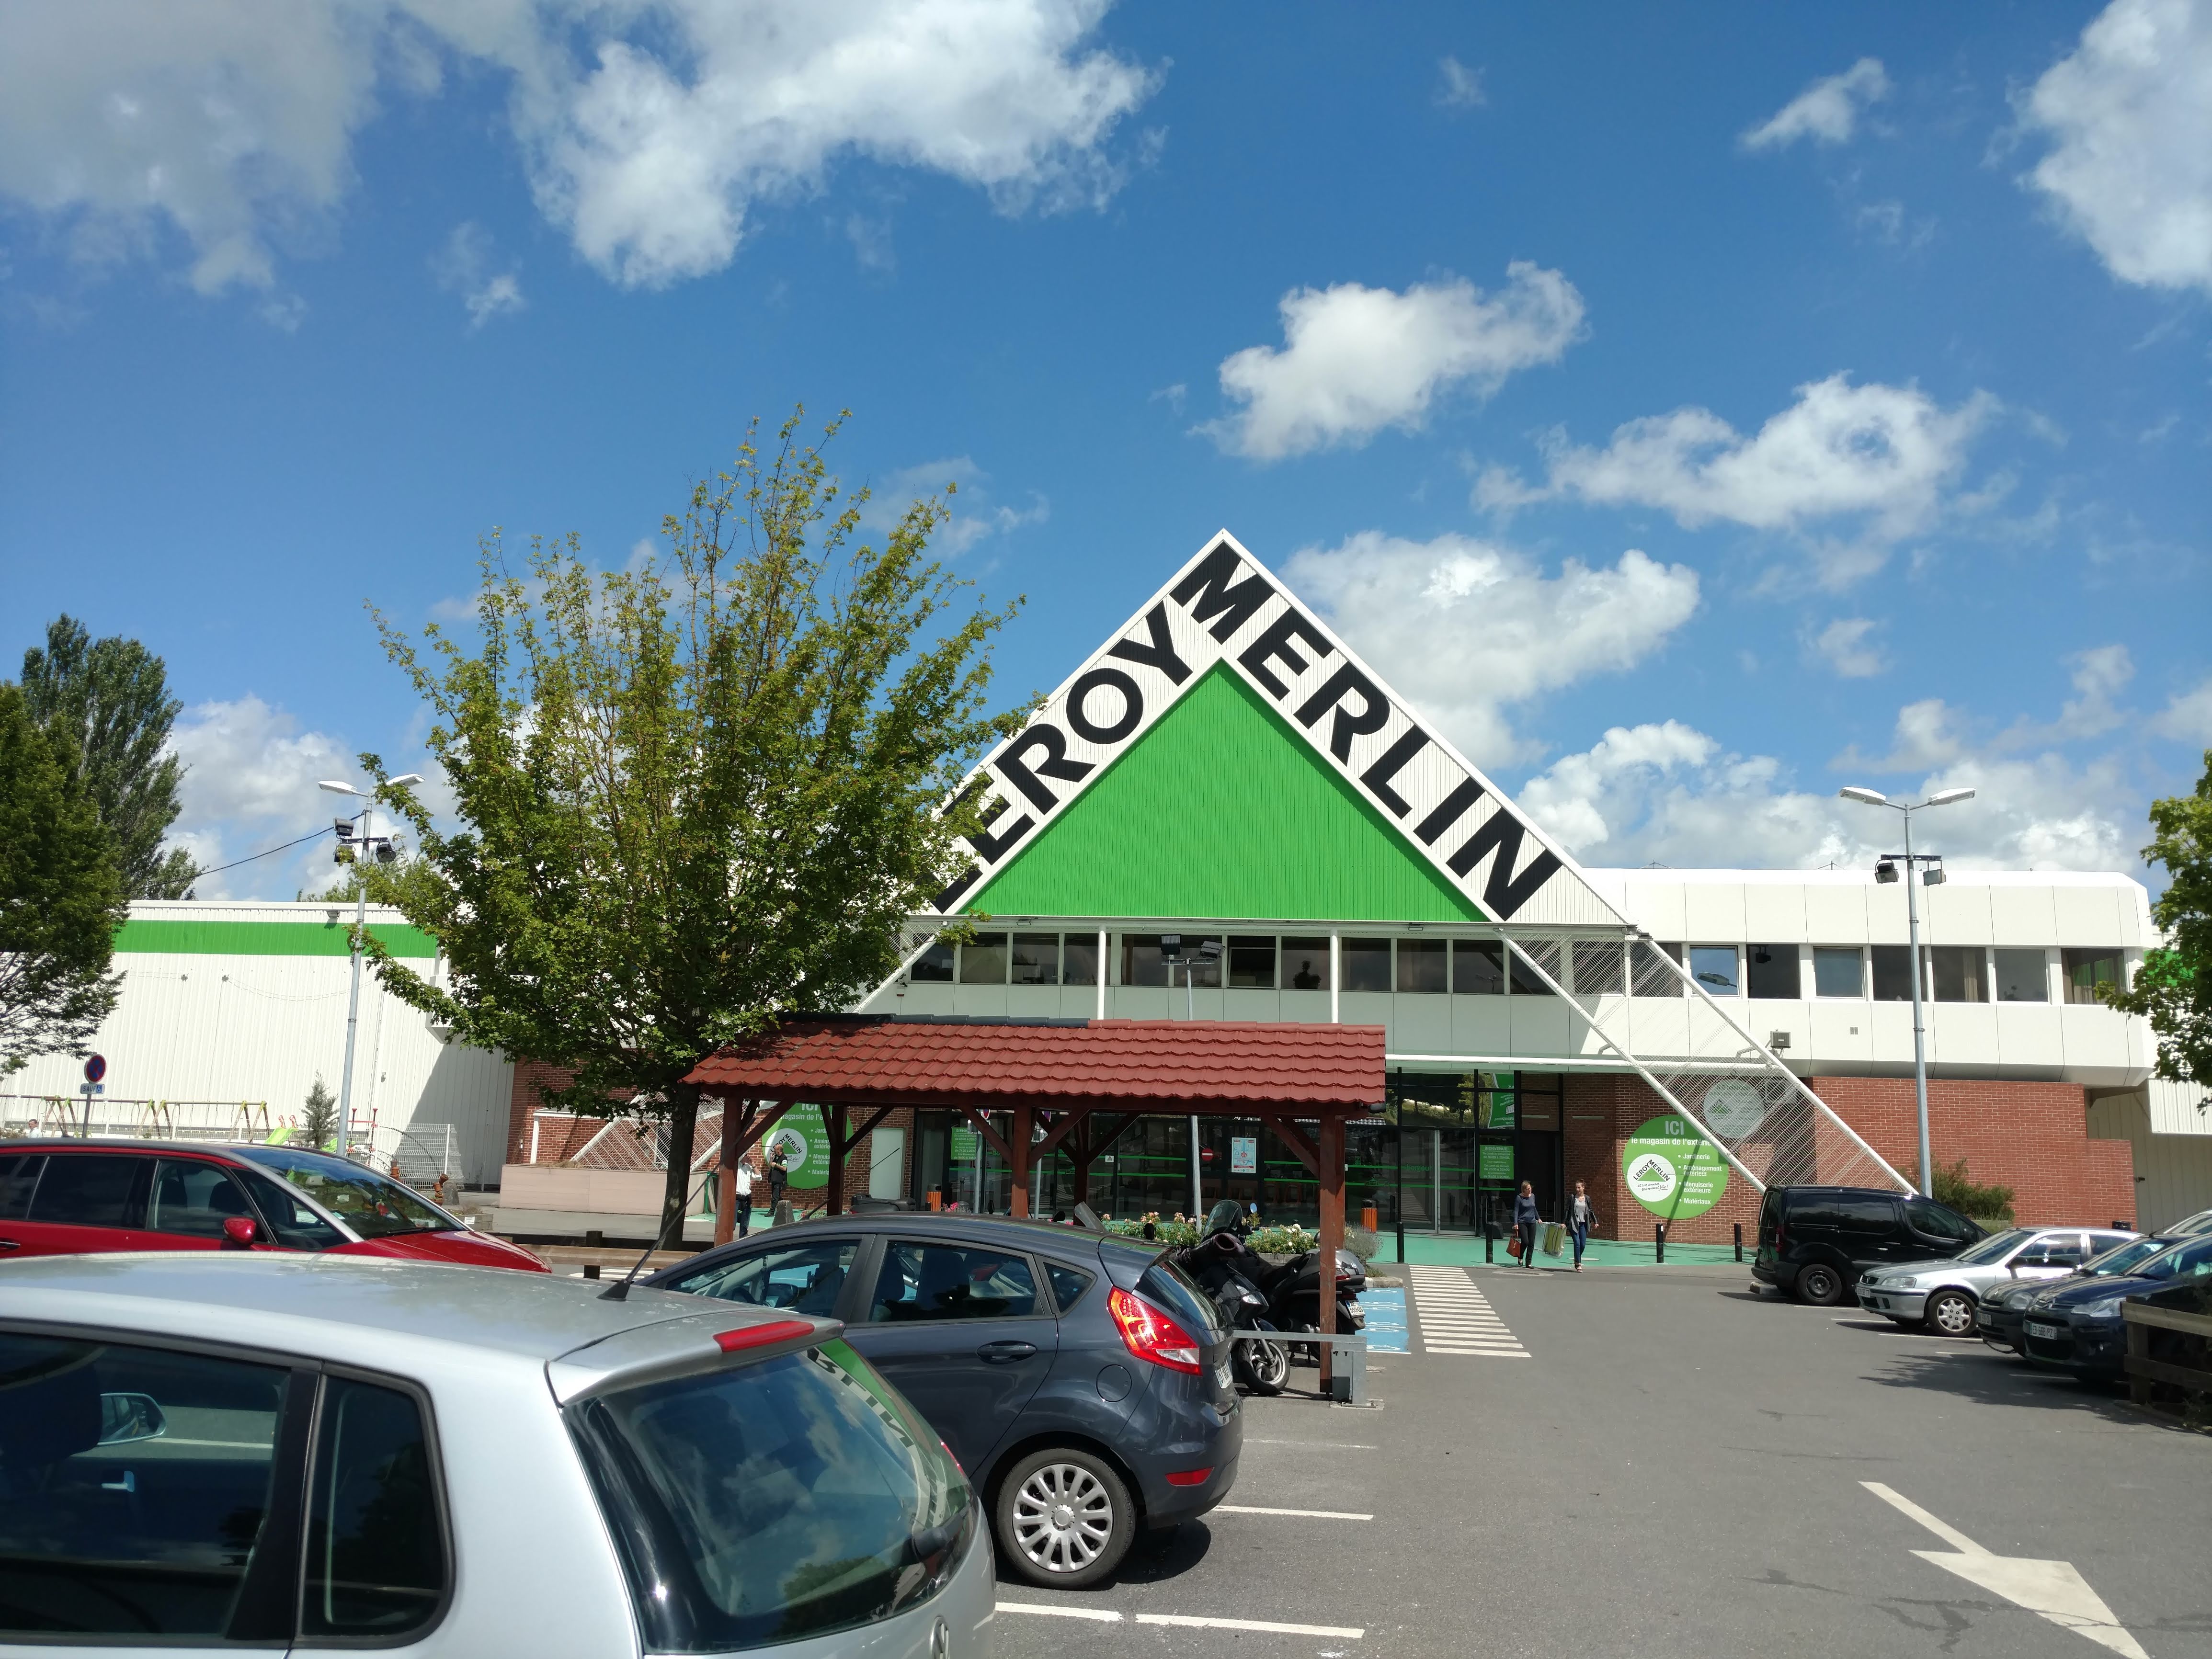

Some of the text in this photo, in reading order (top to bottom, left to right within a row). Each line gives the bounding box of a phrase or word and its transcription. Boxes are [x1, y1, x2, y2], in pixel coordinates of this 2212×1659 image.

[1169, 542, 1562, 920] MERLIN
[914, 602, 1192, 914] LEROY
[1665, 1121, 1684, 1135] ICI
[784, 1133, 802, 1154] MERLIN
[1633, 1163, 1650, 1180] LEROY
[1648, 1159, 1670, 1182] MERLIN
